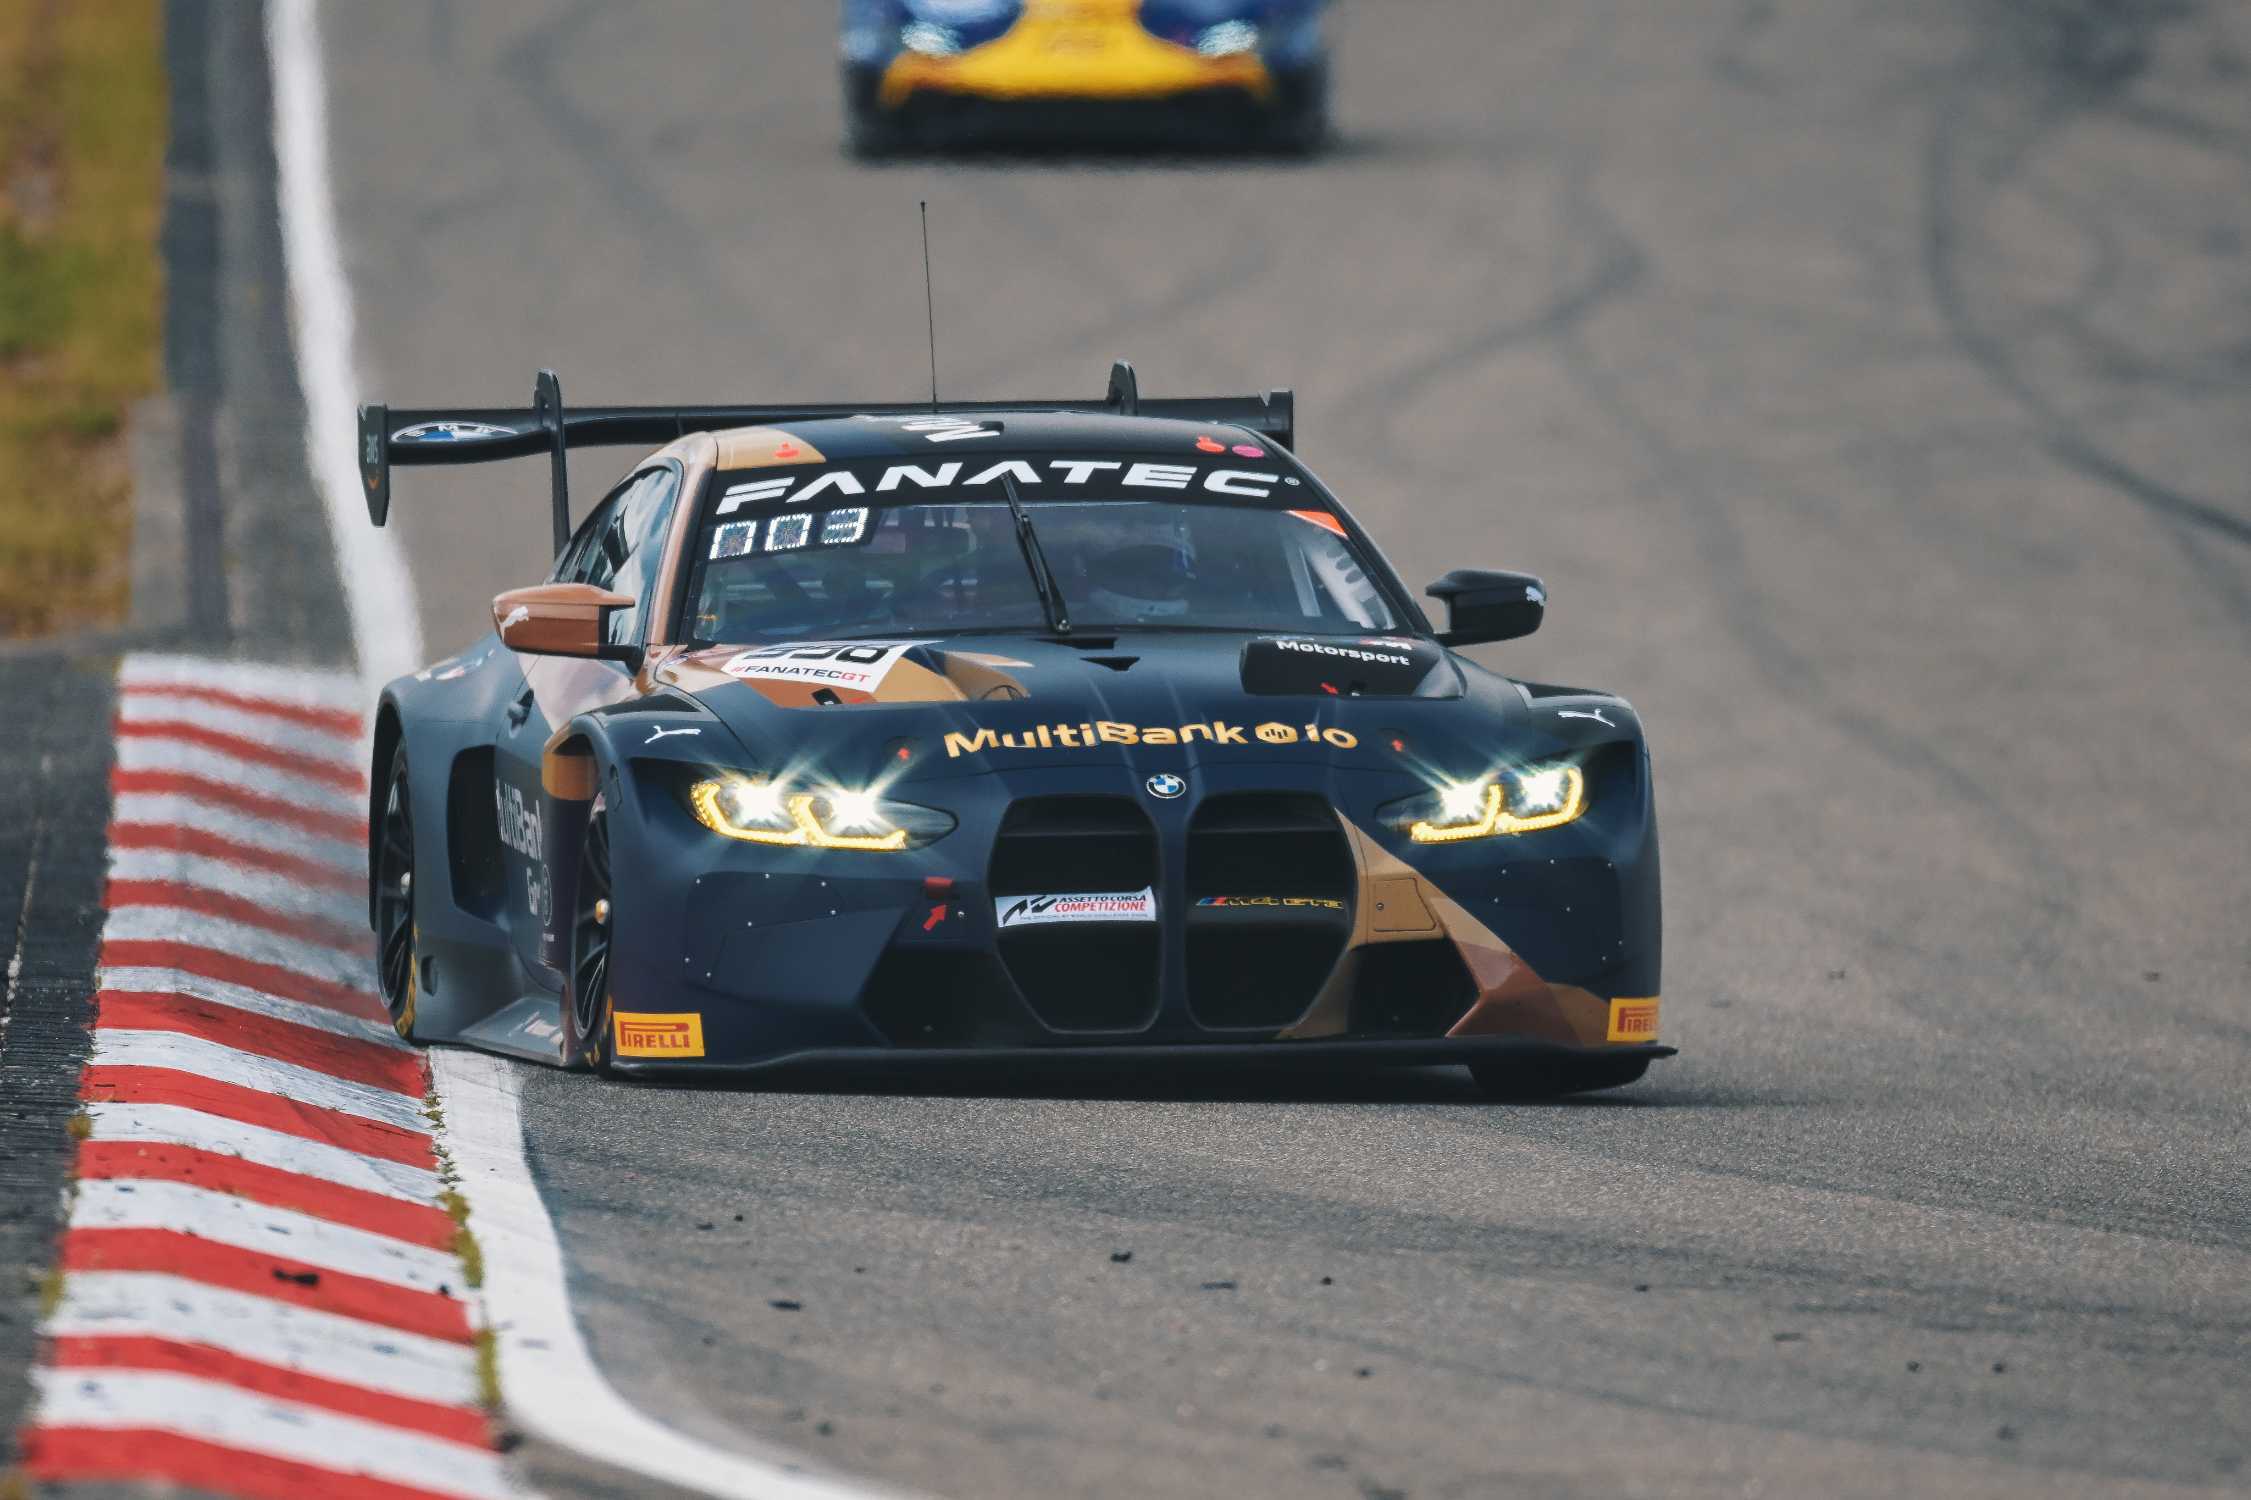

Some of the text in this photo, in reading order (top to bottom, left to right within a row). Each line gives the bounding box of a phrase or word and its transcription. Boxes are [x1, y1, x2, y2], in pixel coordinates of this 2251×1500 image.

[1276, 640, 1411, 666] Motorsport
[731, 665, 872, 683] #FANATECGT
[943, 720, 1249, 758] MultiBank
[1055, 901, 1146, 913] COMPETIZIONE
[620, 1021, 690, 1049] PIRELLI
